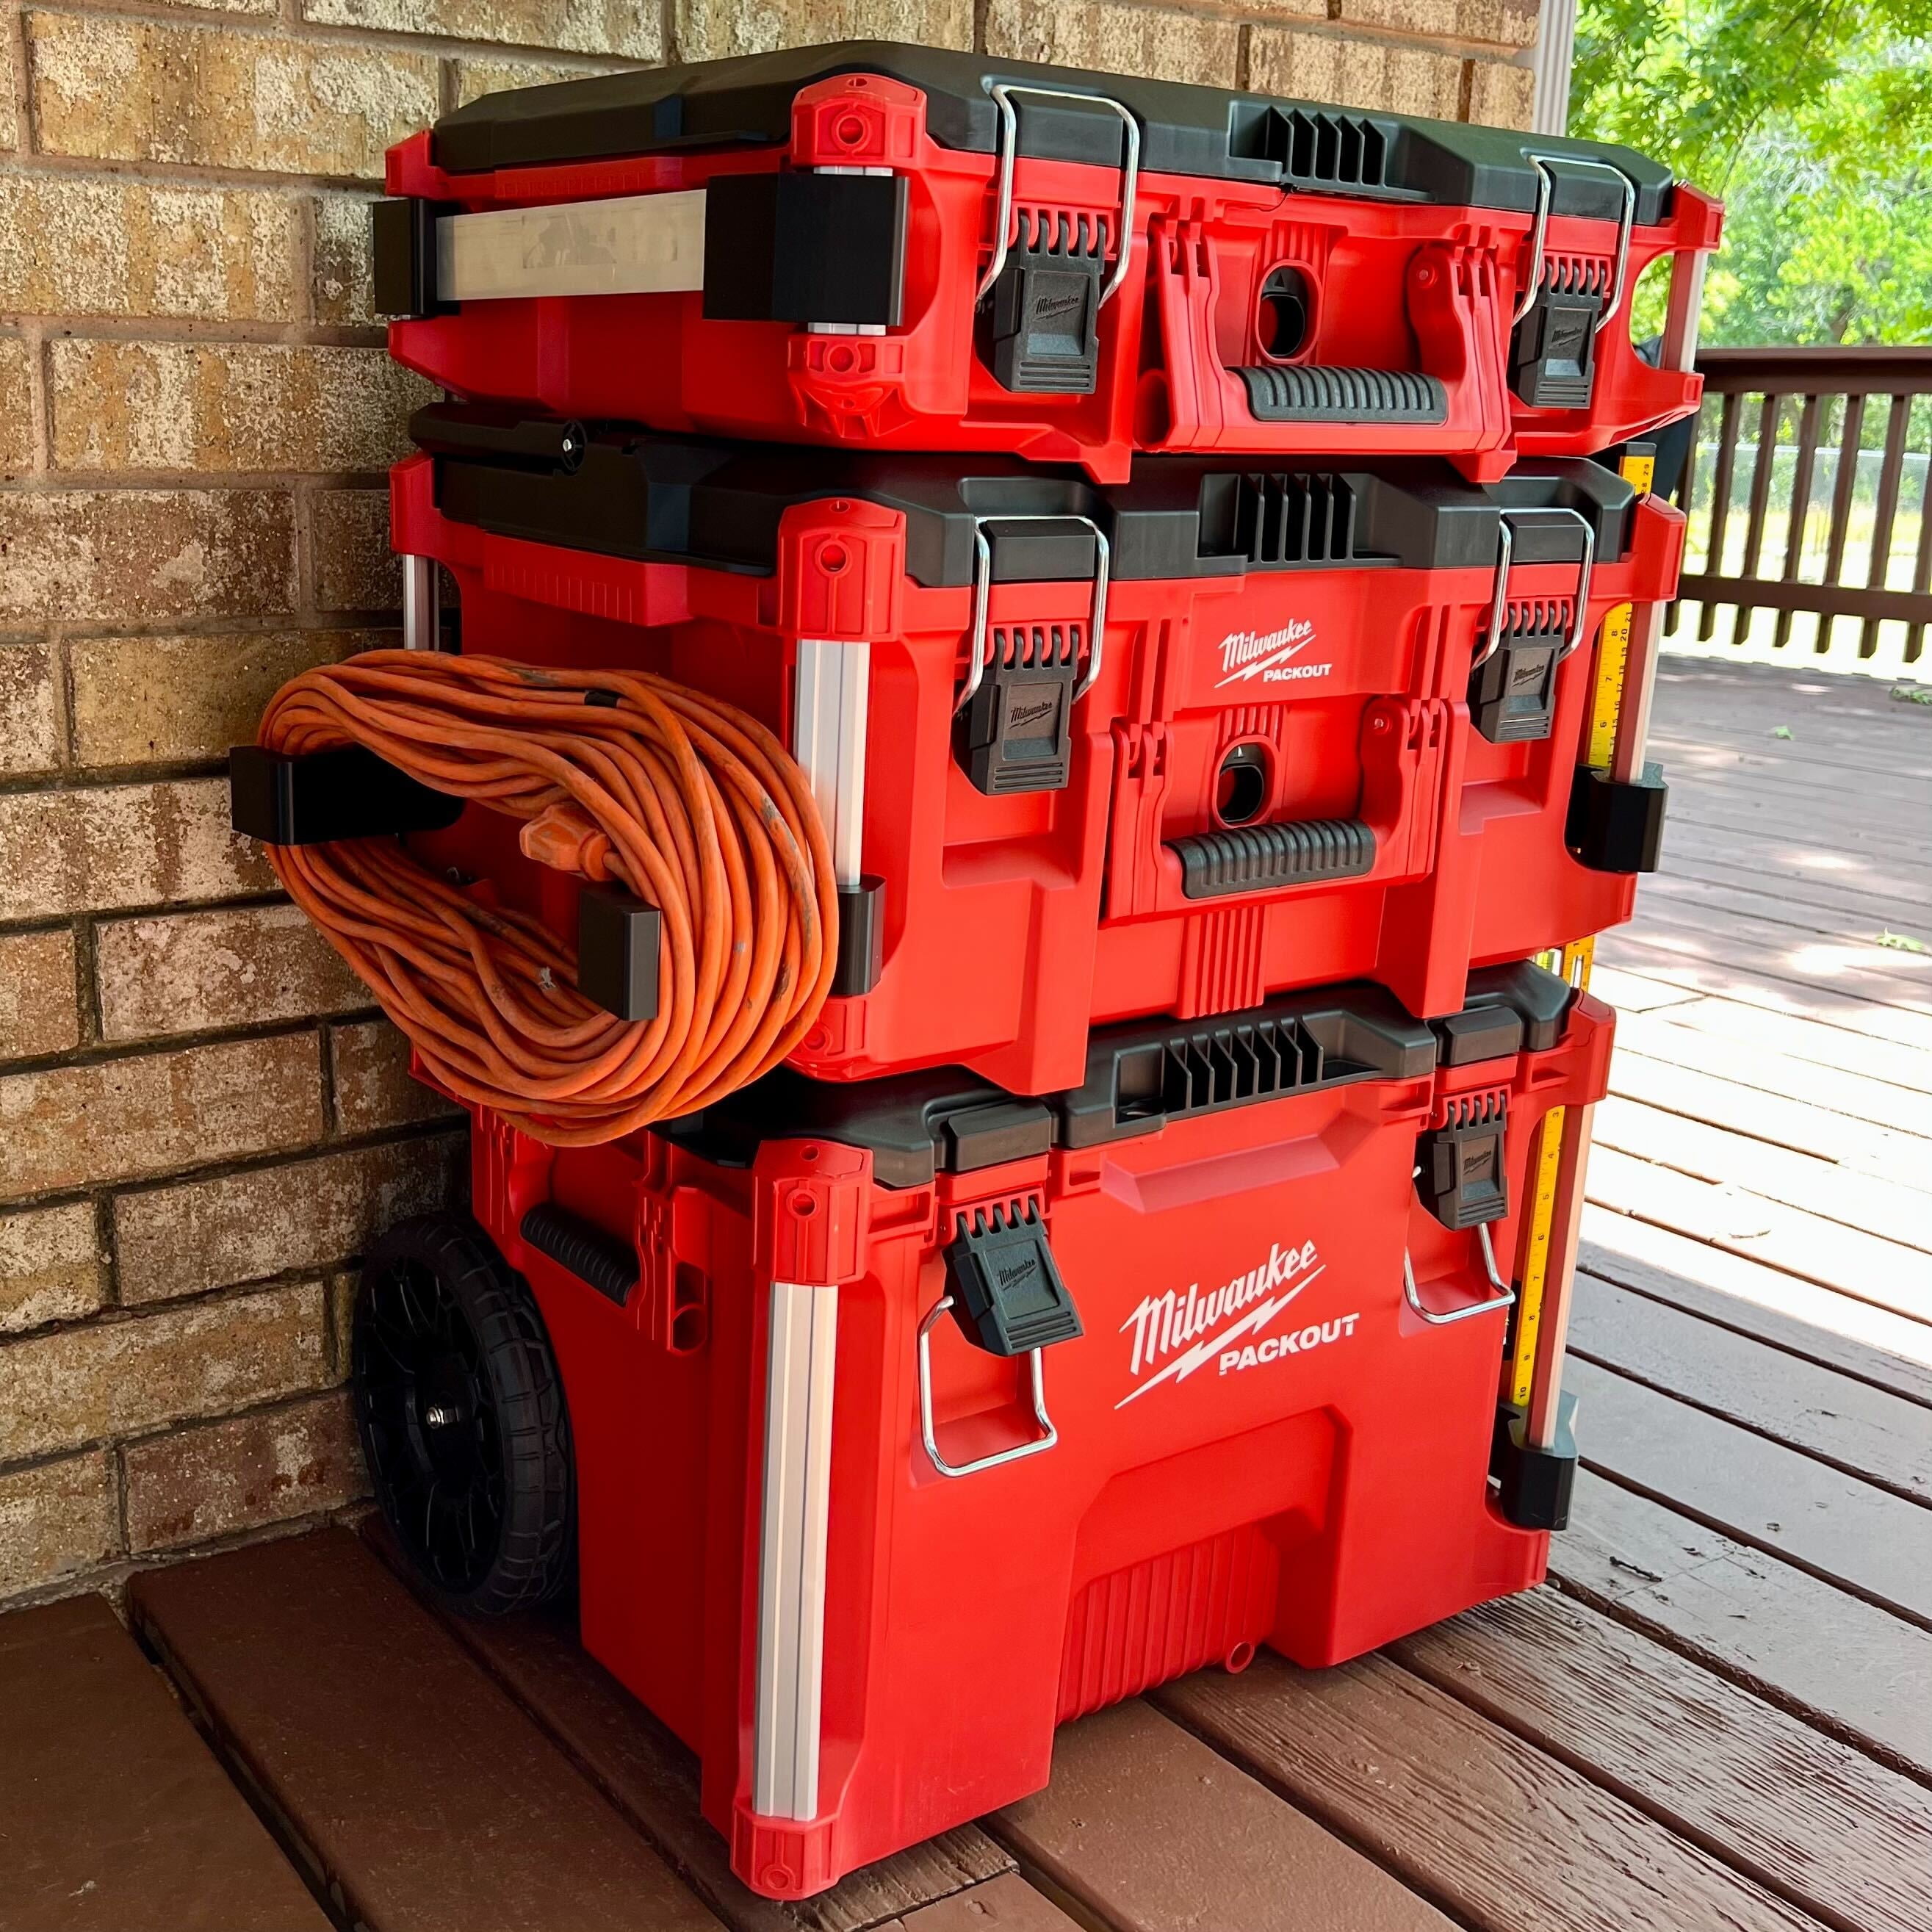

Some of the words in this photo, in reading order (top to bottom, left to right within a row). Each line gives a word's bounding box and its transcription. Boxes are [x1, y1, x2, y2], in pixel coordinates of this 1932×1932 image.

[1217, 618, 1313, 673] Milwaukee
[1620, 629, 1628, 642] 20
[1263, 663, 1333, 682] PACKOUT
[1118, 1239, 1318, 1376] Milwaukee
[1219, 1312, 1360, 1376] PACKOUT
